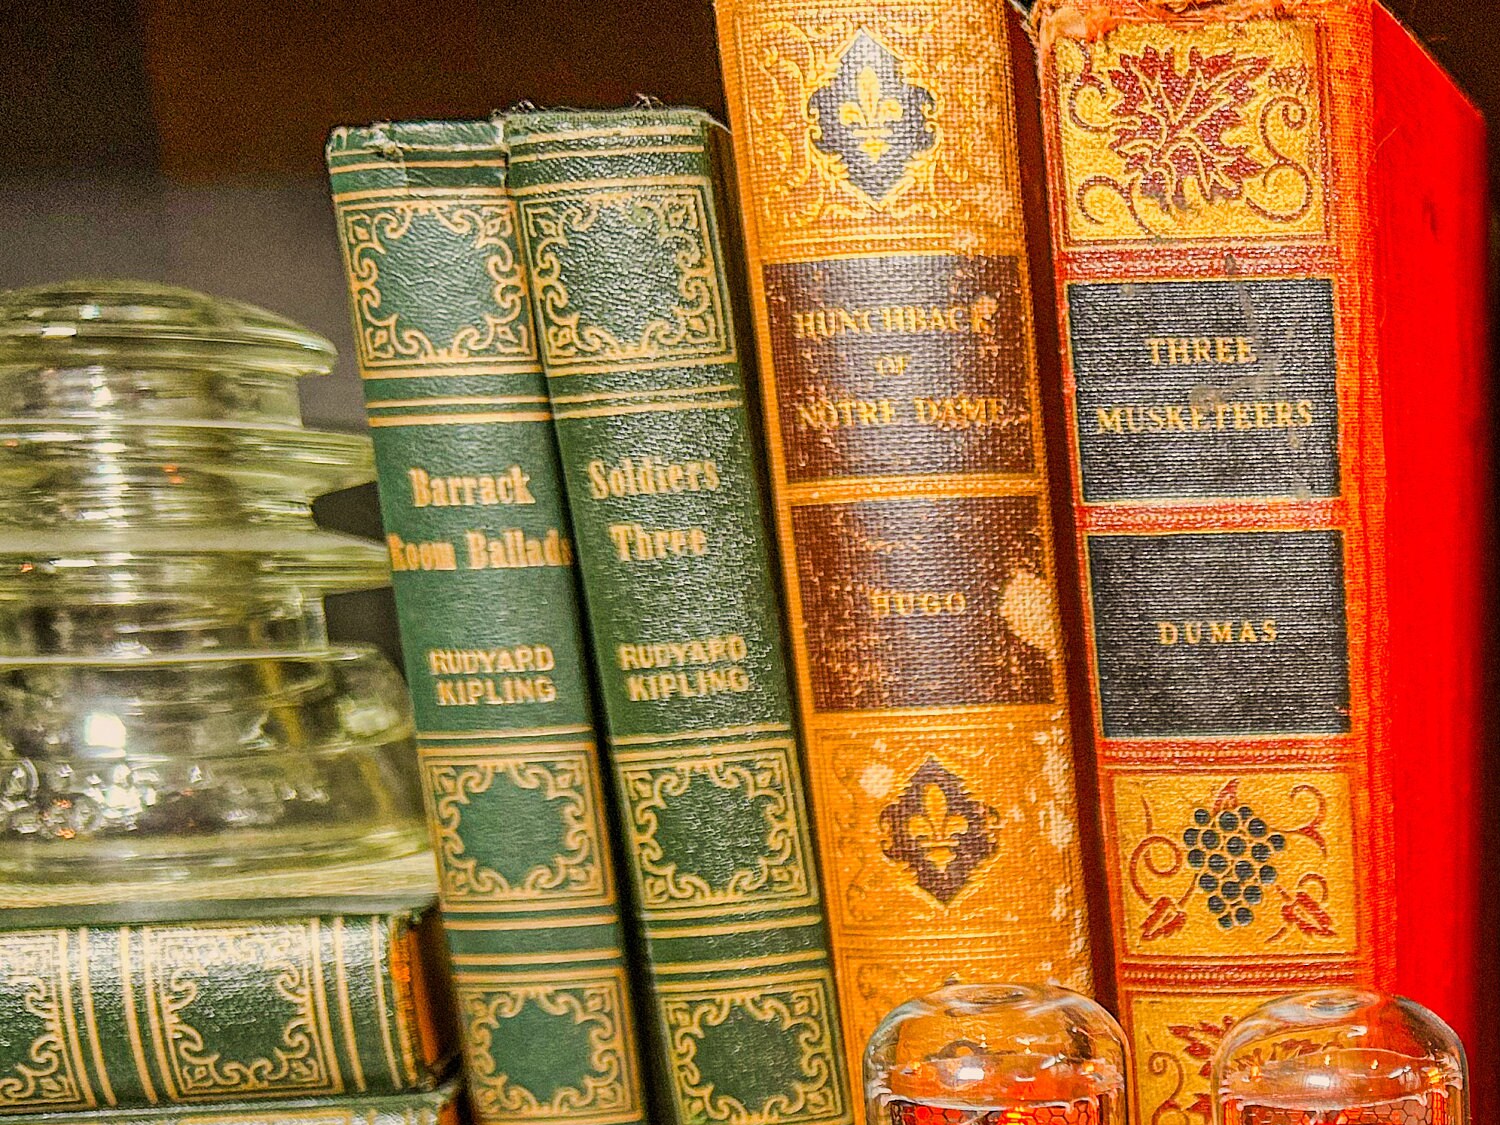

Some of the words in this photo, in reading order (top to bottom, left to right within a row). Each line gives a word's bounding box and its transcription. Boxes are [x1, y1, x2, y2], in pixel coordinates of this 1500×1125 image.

[792, 304, 996, 339] HUNCHBACK
[1144, 335, 1257, 365] THREE
[799, 398, 897, 431] NOTRE
[1095, 398, 1313, 435] MUSKETEERS
[408, 463, 536, 508] Barrack
[587, 455, 721, 501] Soldiers
[387, 532, 457, 571] Room
[464, 527, 574, 570] Ballads
[608, 521, 708, 562] Three
[867, 590, 967, 617] HUGO
[1157, 618, 1278, 645] DUMAS
[429, 643, 556, 675] RUDYARD
[616, 633, 749, 672] RUDYARD
[436, 676, 557, 706] KIPLING
[626, 667, 750, 702] KIPLING
